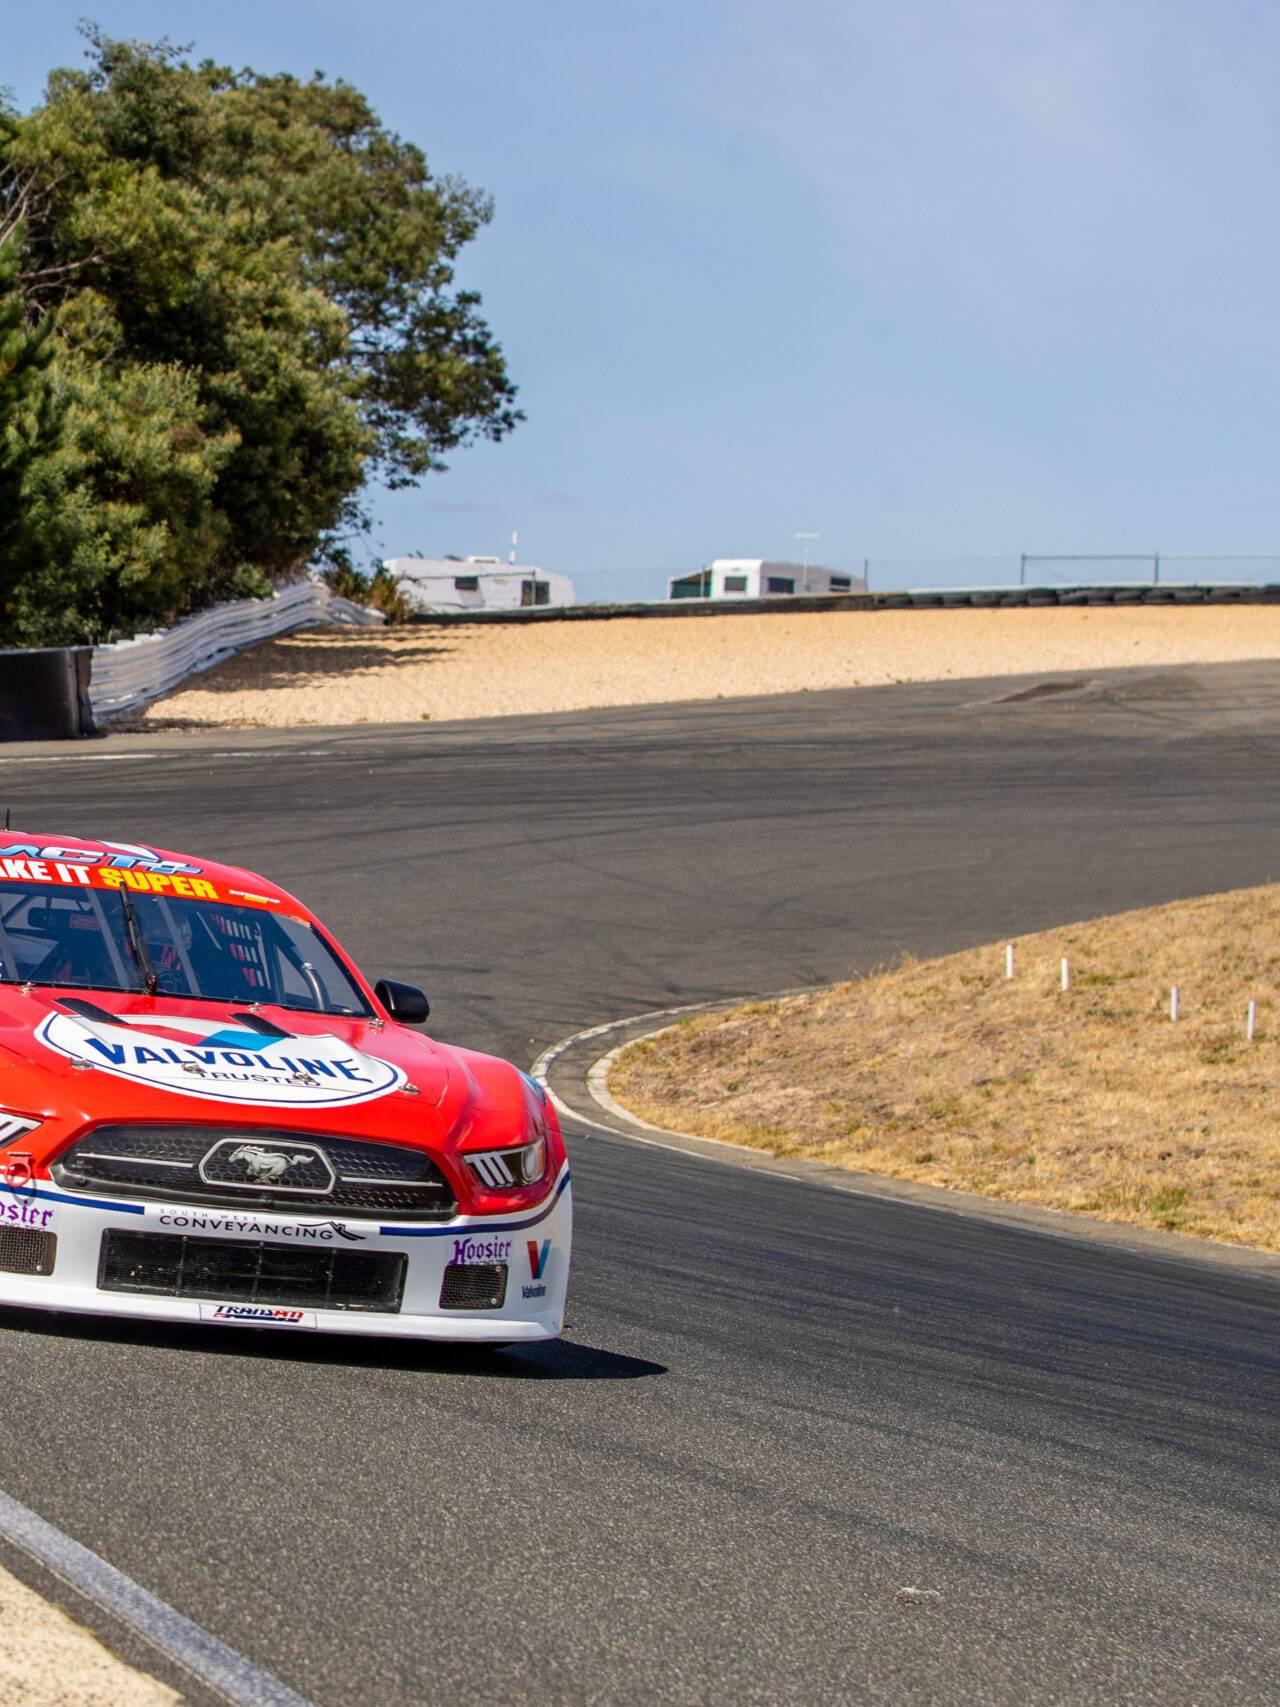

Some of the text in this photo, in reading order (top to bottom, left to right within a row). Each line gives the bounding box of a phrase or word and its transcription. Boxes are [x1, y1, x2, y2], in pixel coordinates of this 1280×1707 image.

[54, 862, 92, 885] IT
[97, 867, 220, 900] SUPER
[83, 1037, 374, 1084] VALVOLINE
[159, 1215, 334, 1240] CONVEYANCING
[160, 1208, 259, 1222] SOUTH WEST
[448, 1234, 513, 1265] Hoosier
